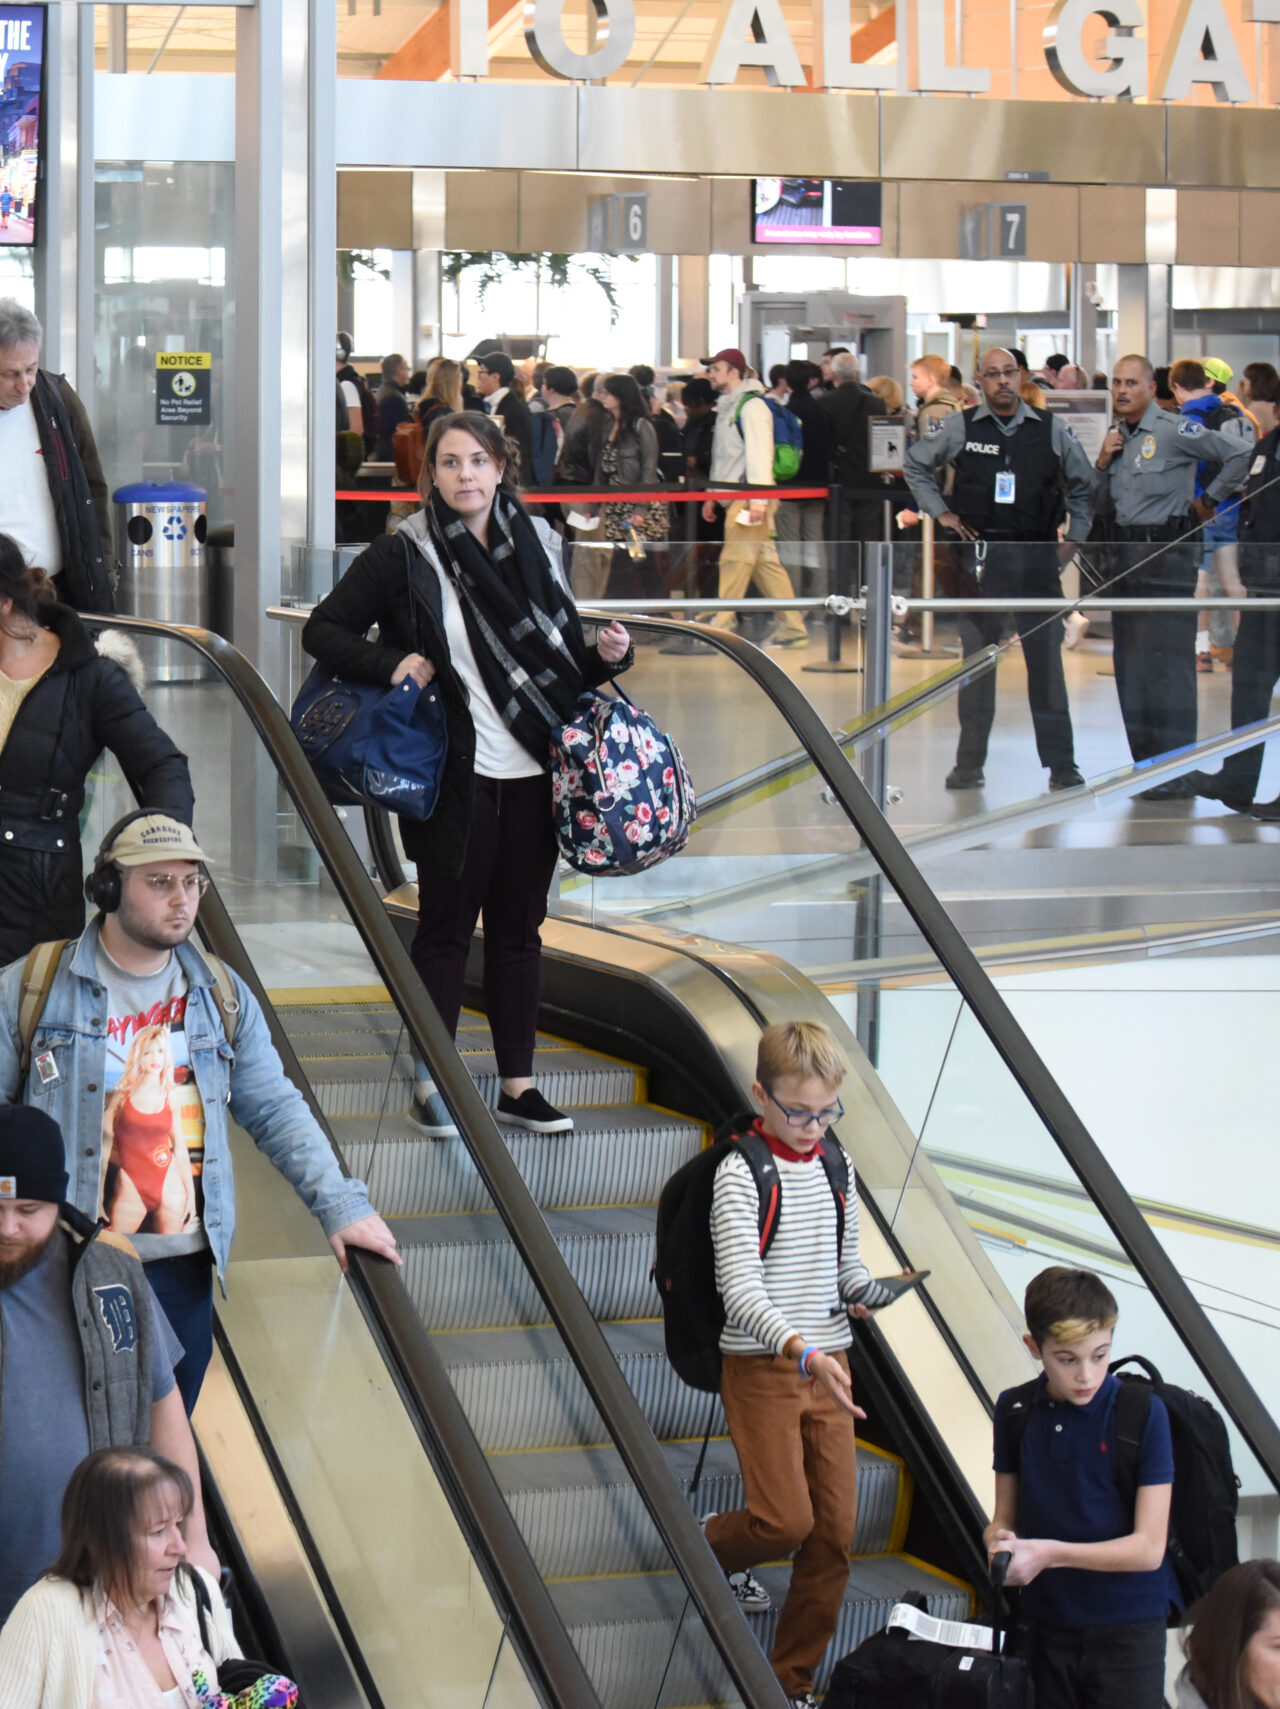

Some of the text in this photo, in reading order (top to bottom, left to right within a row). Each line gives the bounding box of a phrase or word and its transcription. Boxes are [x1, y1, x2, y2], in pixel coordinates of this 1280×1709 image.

[450, 0, 1280, 101] TO ALL GA
[628, 204, 642, 241] 6
[1006, 213, 1020, 249] 7
[161, 356, 203, 366] NOTICE
[160, 414, 188, 422] Security
[965, 441, 1000, 455] POLICE
[145, 505, 201, 513] NEWSPAPERS
[131, 549, 154, 557] CANS
